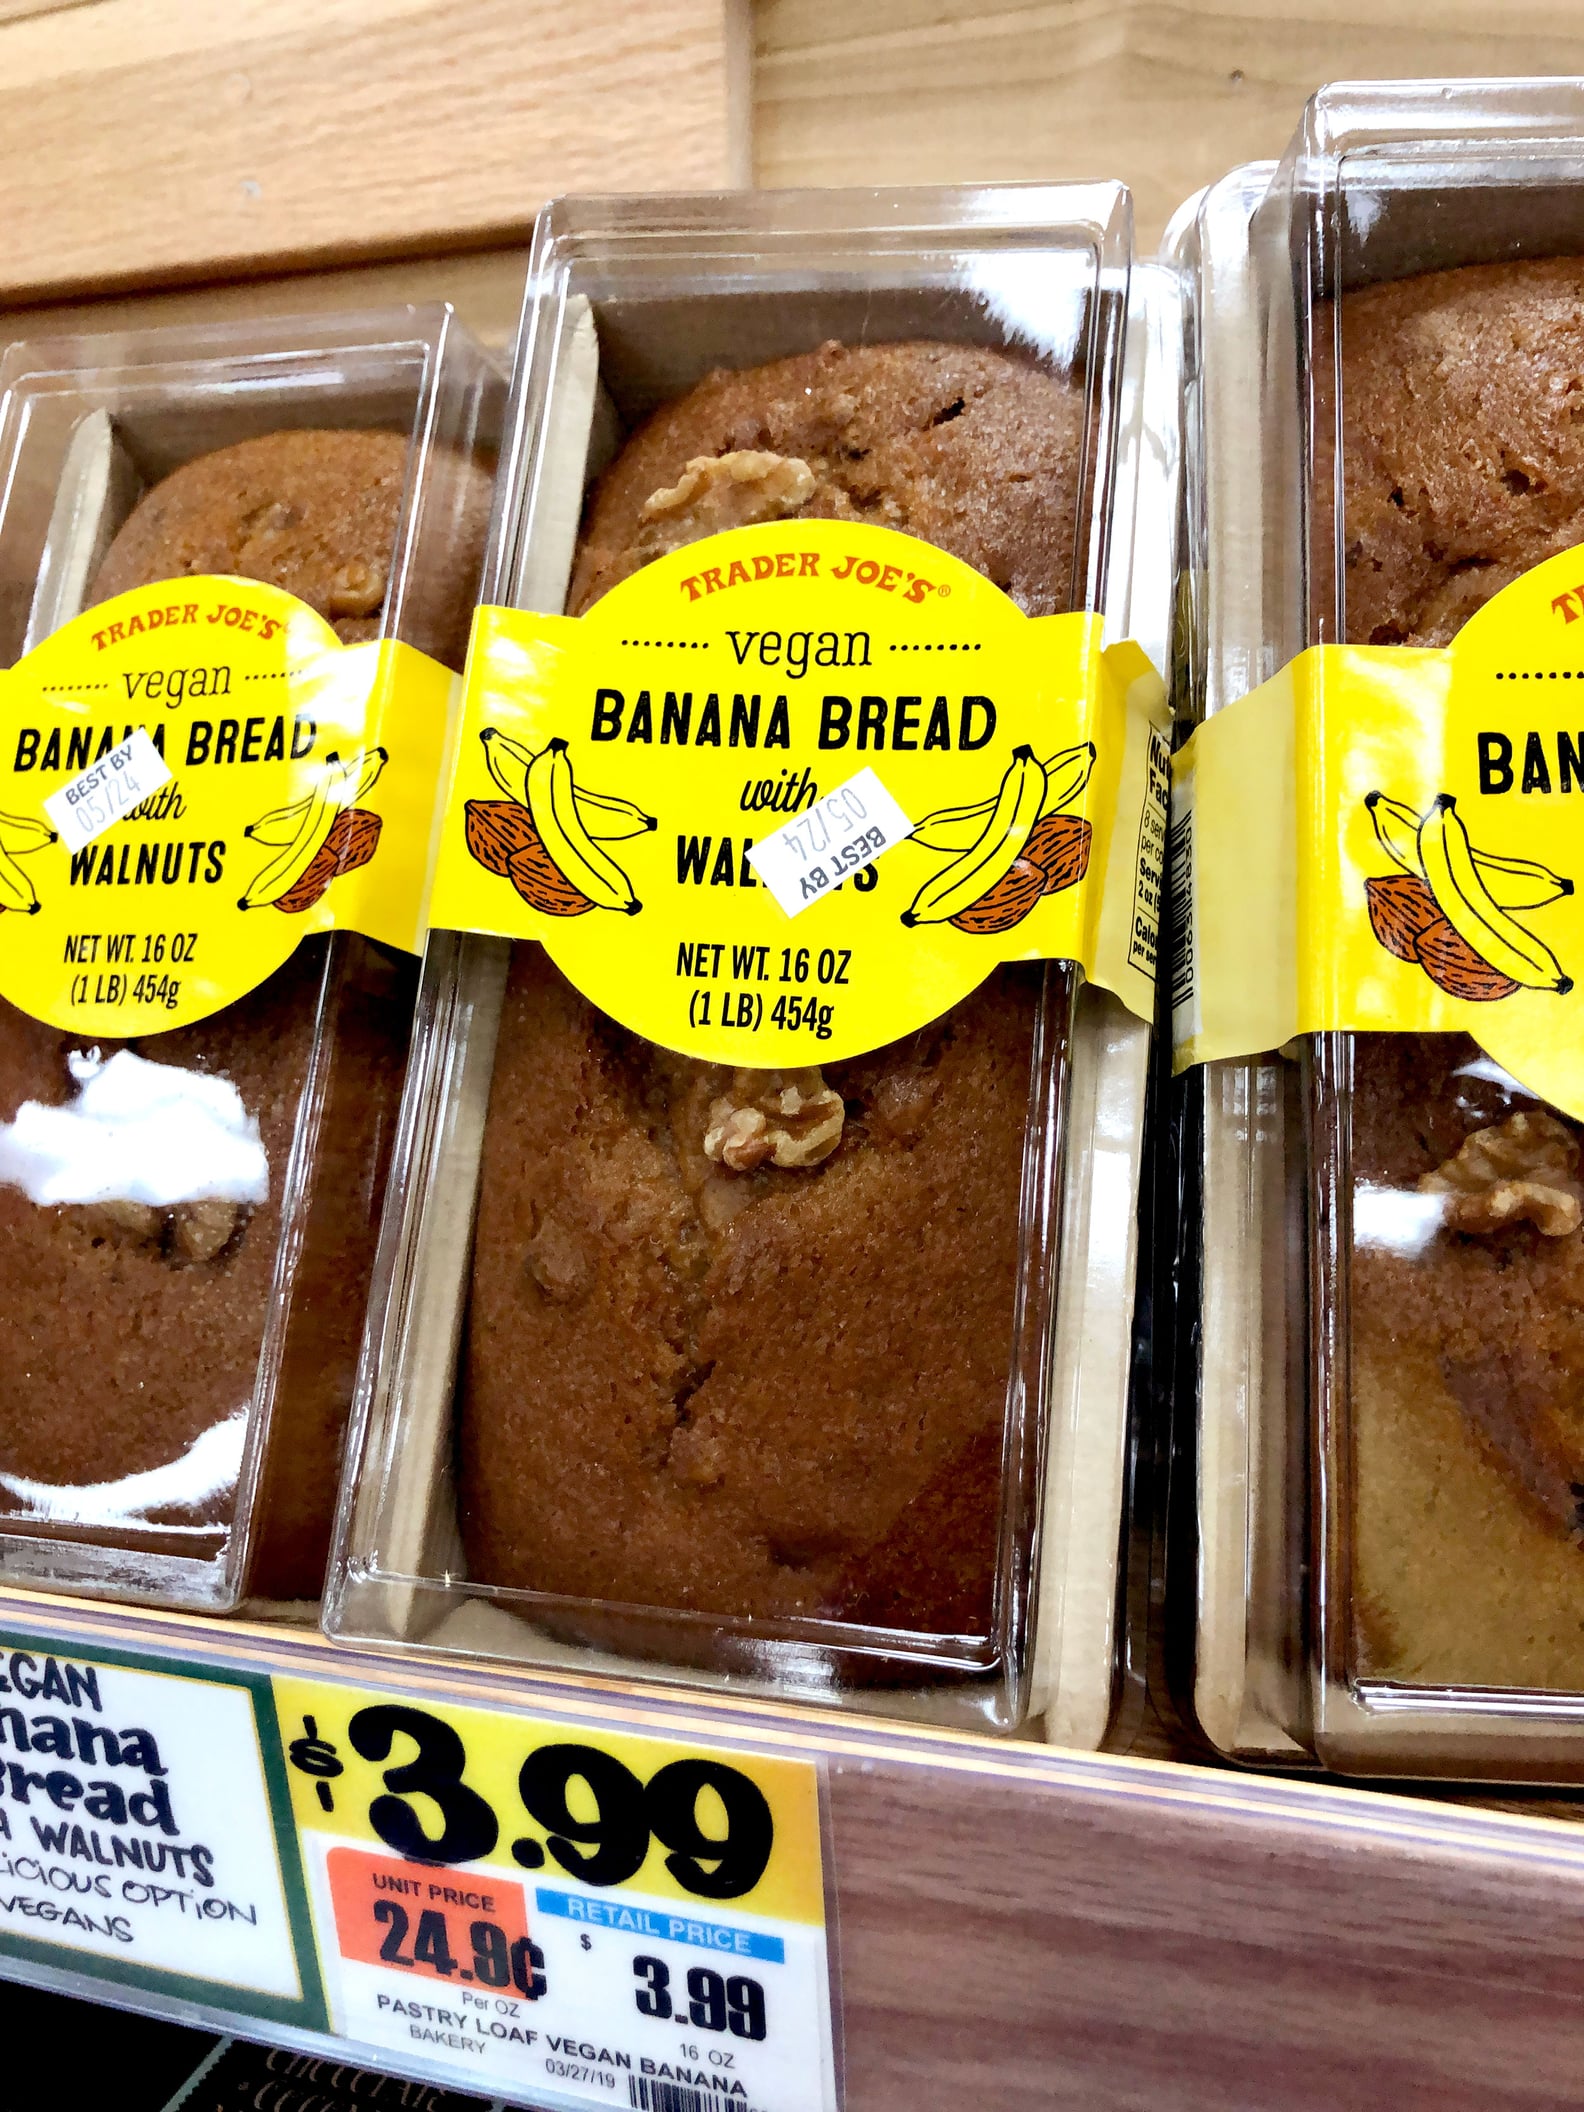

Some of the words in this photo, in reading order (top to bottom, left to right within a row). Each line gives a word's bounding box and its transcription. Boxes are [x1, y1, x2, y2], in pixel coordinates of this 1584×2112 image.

[680, 552, 820, 602] TRADER
[92, 603, 198, 651] TRADER
[725, 628, 872, 679] vegan
[122, 666, 231, 710] vegan
[186, 714, 316, 766] BREAD
[591, 689, 792, 749] BANANA
[817, 696, 997, 752] BREAD
[66, 764, 107, 805] BEST
[110, 744, 133, 771] BY
[740, 767, 824, 813] with
[76, 771, 141, 832] 05/24
[782, 788, 867, 861] 05/24
[70, 840, 226, 886] WALNUTS
[829, 826, 886, 877] BEST
[799, 866, 830, 899] BY
[63, 935, 101, 965] NET
[104, 935, 134, 964] WT.
[141, 934, 168, 963] 16
[171, 933, 197, 962] OZ
[676, 942, 725, 978] NET
[733, 945, 768, 979] WT.
[779, 946, 809, 982] 16
[817, 948, 852, 984] OZ
[70, 977, 90, 1006] (1
[96, 975, 127, 1005] LB)
[133, 975, 181, 1009] 454g
[688, 989, 716, 1028] (1
[721, 992, 763, 1030] LB)
[770, 993, 834, 1040] 454g
[30, 1816, 215, 1888] WALNUTS
[372, 1872, 422, 1897] UNIT
[428, 1883, 496, 1913] PRICE
[567, 1898, 660, 1936] RETAIL
[668, 1919, 751, 1952] PRICE
[462, 1991, 489, 2010] Per
[495, 1999, 521, 2019] OZ
[633, 1954, 767, 2042] 3.99
[376, 1993, 467, 2029] PASTRY
[476, 2018, 538, 2046] LOAF
[546, 2034, 631, 2070] VEGAN
[640, 2057, 748, 2099] BANANA
[409, 2023, 486, 2055] BAKERY
[680, 2043, 699, 2061] 16
[708, 2049, 736, 2070] OZ
[545, 2057, 615, 2089] 03/27/19
